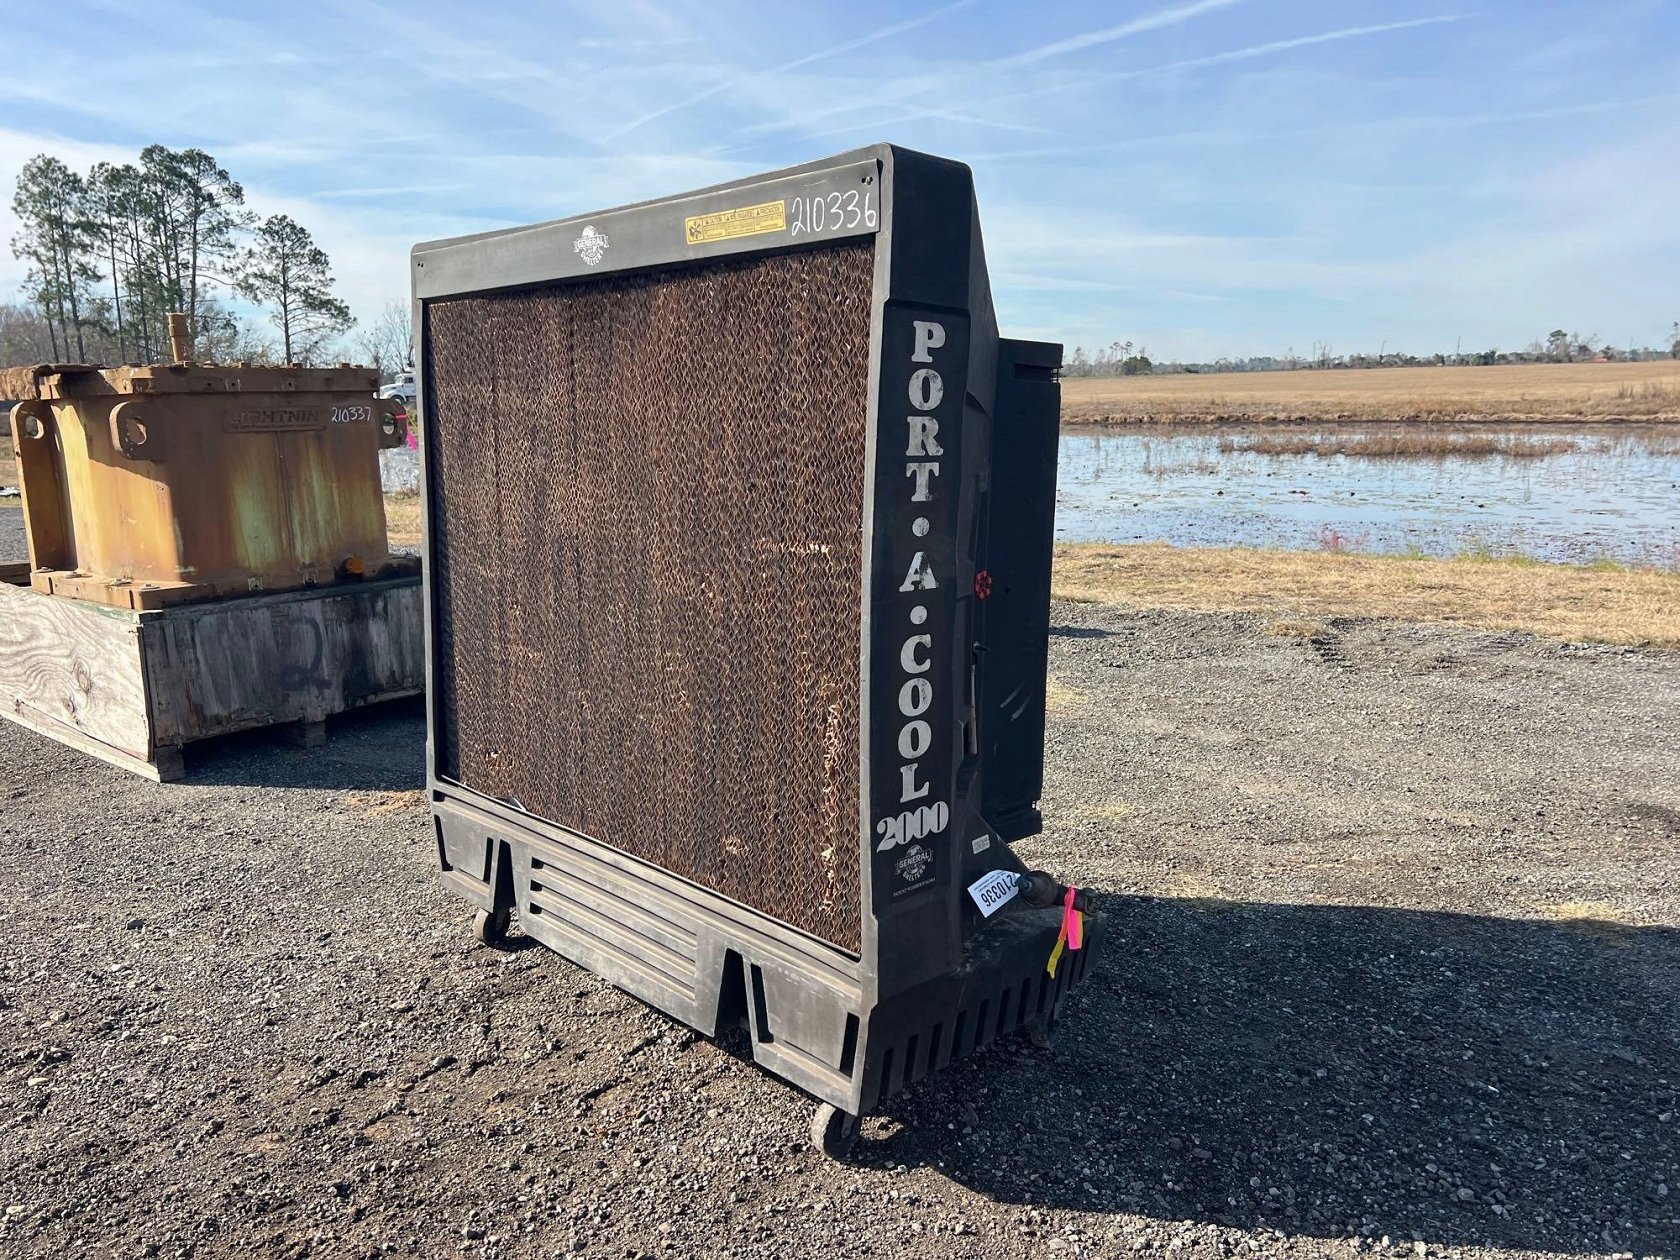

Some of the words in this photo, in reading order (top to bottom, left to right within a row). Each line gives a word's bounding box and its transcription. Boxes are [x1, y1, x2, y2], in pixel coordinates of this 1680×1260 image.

[790, 190, 877, 236] 210336
[578, 236, 604, 249] GENERAL
[330, 406, 371, 423] 210337
[876, 801, 950, 853] 2000
[898, 852, 930, 869] GENERAL
[980, 873, 1018, 907] 210336
